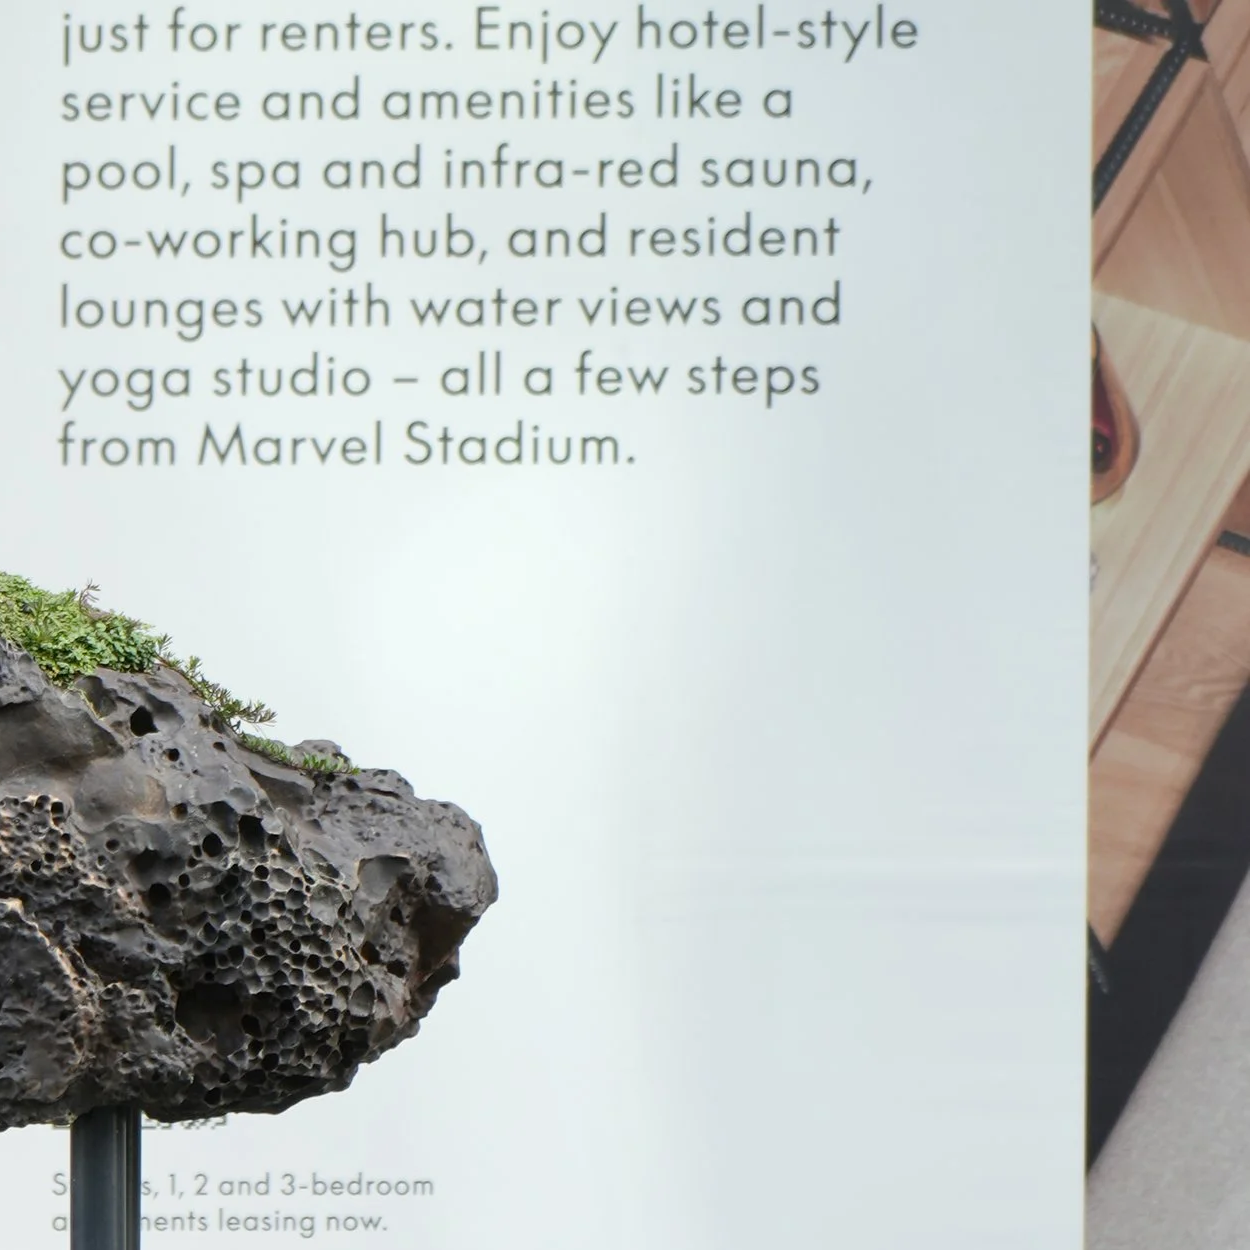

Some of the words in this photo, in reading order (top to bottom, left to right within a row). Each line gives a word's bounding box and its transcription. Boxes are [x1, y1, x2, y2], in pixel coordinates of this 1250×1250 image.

[63, 12, 150, 67] just
[167, 5, 241, 52] for
[261, 12, 453, 52] renters.
[476, 5, 619, 65] Enjoy
[637, 2, 919, 64] hotel-style
[61, 81, 241, 122] service
[261, 74, 360, 121] and
[382, 78, 635, 121] amenities
[656, 72, 743, 119] like
[762, 88, 793, 119] a
[62, 144, 191, 205] pool,
[211, 160, 300, 204] spa
[322, 143, 421, 190] and
[445, 141, 679, 189] infra-red
[700, 157, 873, 195] sauna,
[59, 213, 357, 273] co-working
[380, 212, 488, 265] hub,
[507, 211, 607, 258] and
[629, 210, 841, 258] resident
[61, 283, 263, 343] lounges
[281, 281, 390, 327] with
[409, 287, 563, 328] water
[577, 285, 722, 327] views
[741, 279, 842, 327] and
[57, 365, 191, 411] yoga
[213, 351, 371, 397] studio
[440, 350, 502, 397] all
[523, 366, 553, 396] a
[574, 349, 670, 396] few
[687, 355, 821, 410] steps
[57, 419, 176, 467] from
[198, 419, 382, 466] Marvel
[404, 419, 635, 466] Stadium.
[169, 1173, 184, 1200] 1,
[194, 1172, 209, 1196] 2
[218, 1171, 271, 1196] and
[280, 1171, 434, 1196] 3-bedroom
[52, 1210, 209, 1233] aents
[218, 1207, 316, 1239] leasing
[325, 1214, 388, 1232] now.
